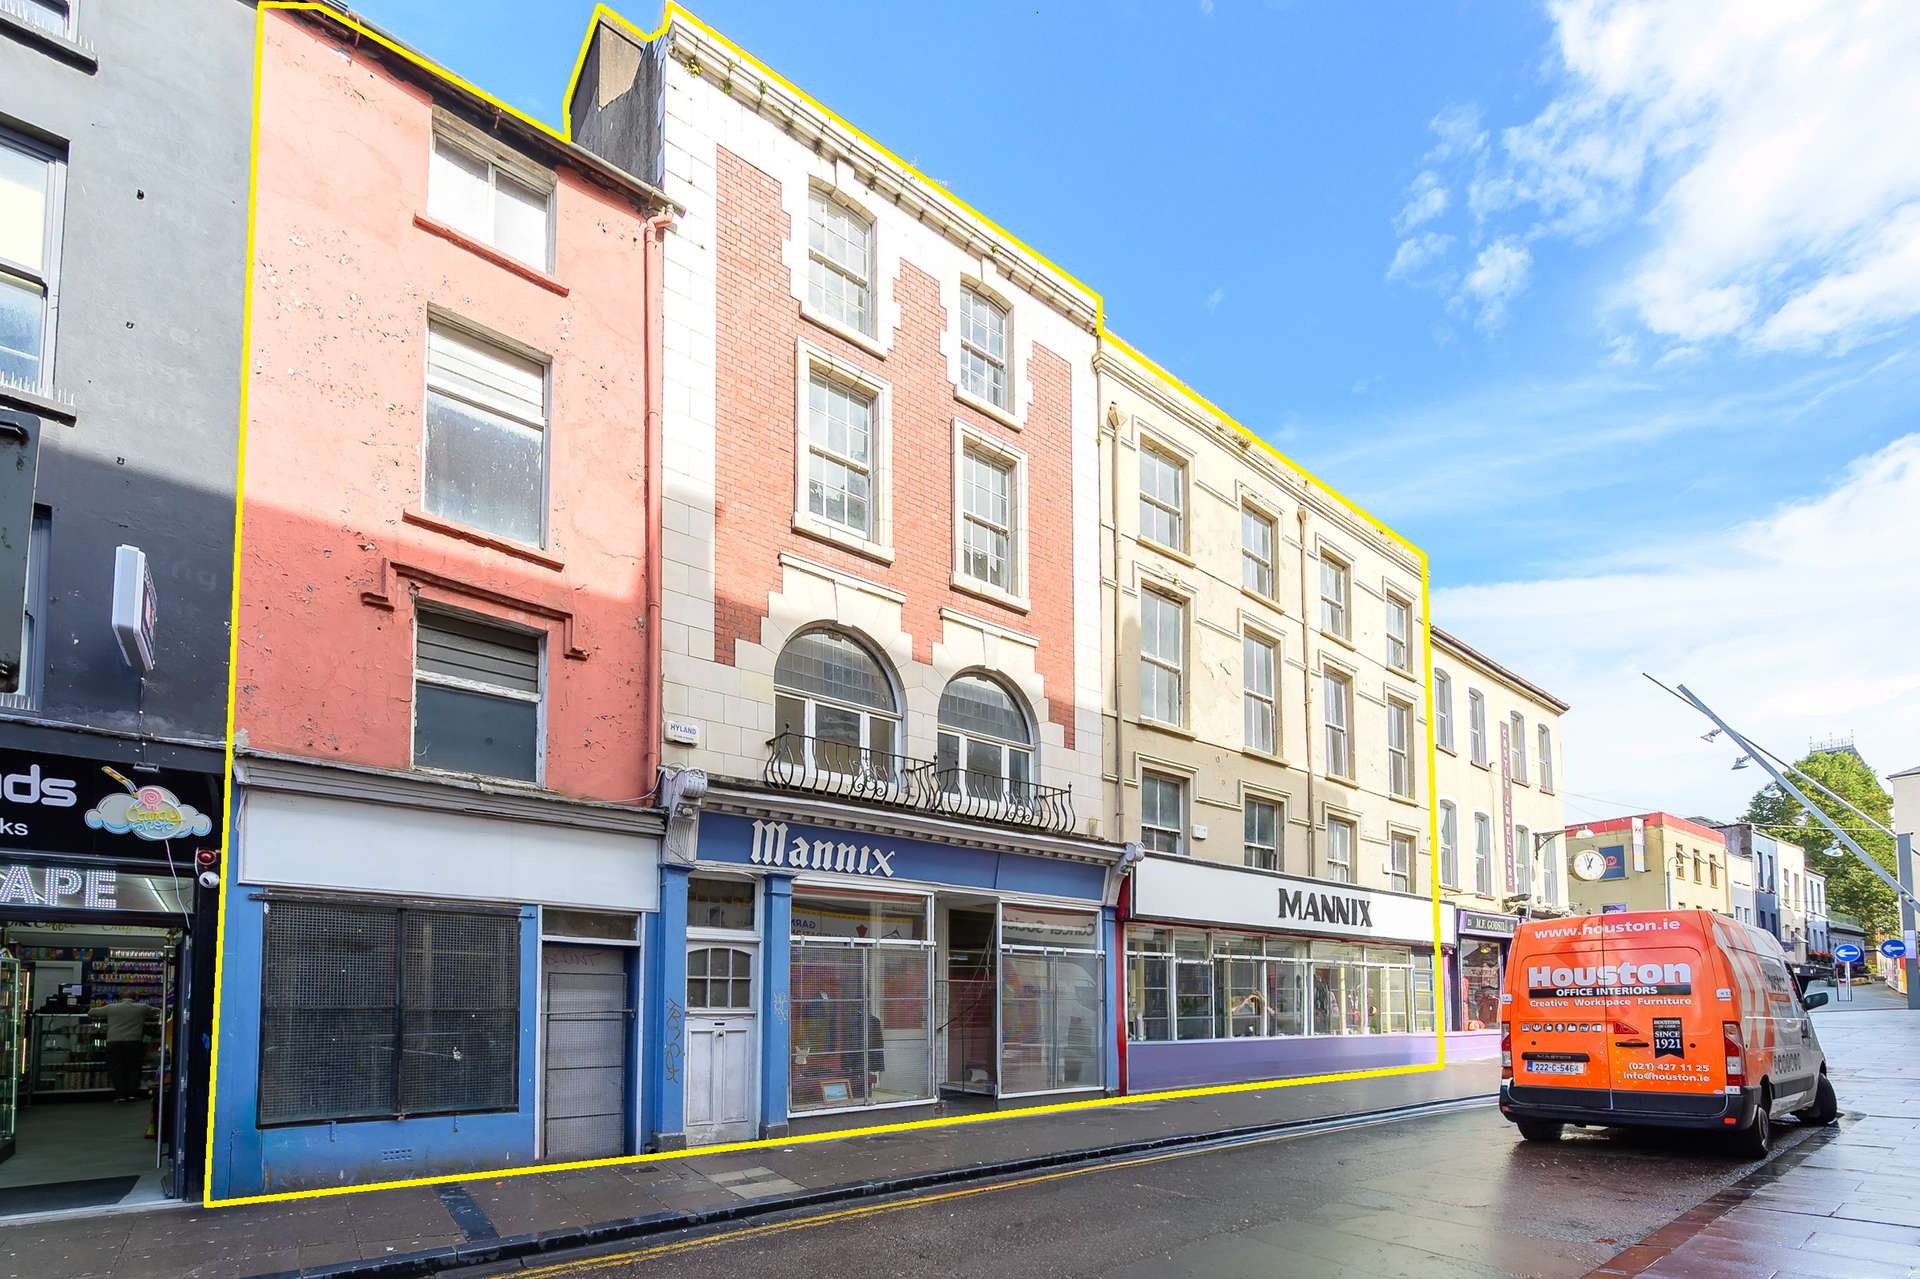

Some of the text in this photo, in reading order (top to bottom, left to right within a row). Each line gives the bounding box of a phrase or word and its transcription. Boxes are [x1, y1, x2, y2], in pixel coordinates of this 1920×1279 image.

[670, 723, 697, 735] HYLAND
[0, 763, 77, 807] ds
[750, 819, 896, 878] Mannix
[1278, 888, 1373, 928] MANNIX
[1535, 918, 1681, 939] www.houston.ie
[1528, 961, 1692, 988] Houston
[1556, 986, 1658, 997] OFFICE INTERIORS
[1529, 997, 1692, 1007] Creative Workspace Furniture
[1654, 1030, 1681, 1038] SINCE
[1655, 1038, 1682, 1049] 1921
[1628, 1062, 1710, 1072] (021) 427 11 25
[1623, 1072, 1711, 1082] info@houston.ie
